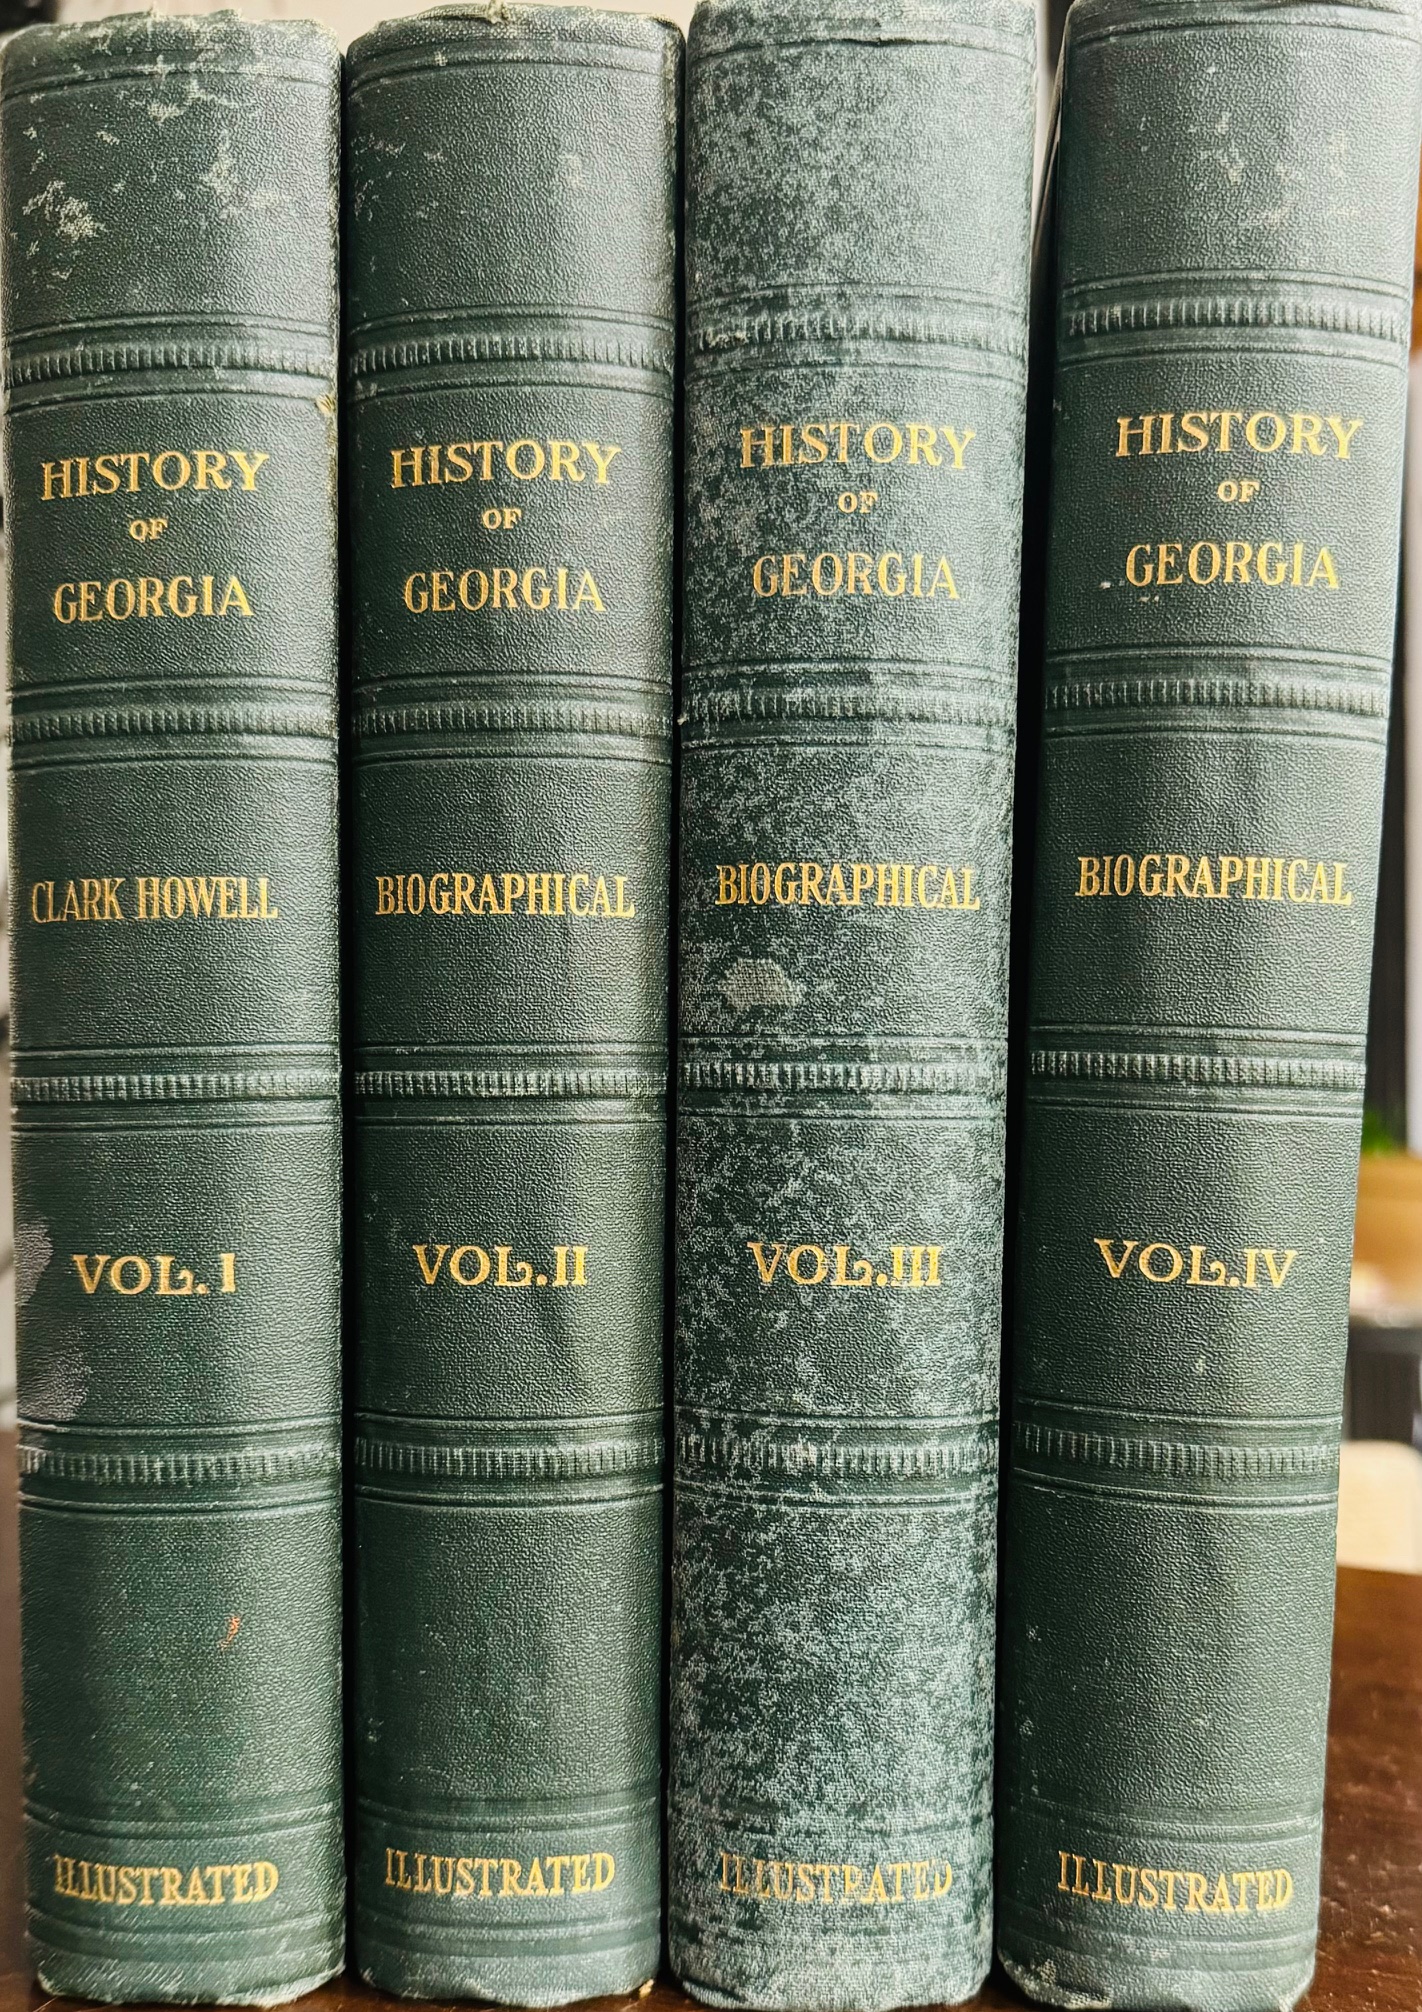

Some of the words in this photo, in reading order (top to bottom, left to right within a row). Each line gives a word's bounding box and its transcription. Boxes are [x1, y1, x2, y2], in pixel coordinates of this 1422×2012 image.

[739, 421, 975, 470] HISTORY
[1116, 411, 1361, 460] HISTORY
[41, 449, 269, 501] HISTORY
[390, 440, 621, 489] HISTORY
[837, 490, 878, 514] OF
[1216, 479, 1260, 503] OF
[128, 517, 169, 542] OF
[481, 507, 523, 530] OF
[752, 552, 958, 600] GEORGIA
[1125, 541, 1339, 589] GEORGIA
[52, 575, 253, 624] GEORGIA
[403, 567, 605, 614] GEORGIA
[31, 878, 124, 924] CLARK
[136, 876, 279, 920] HOWELL
[375, 872, 636, 919] BIOGRAPHICAL
[715, 861, 981, 910] BIOGRAPHICAL
[1075, 854, 1352, 906] BIOGRAPHICAL
[54, 1855, 280, 1907] ILLUSTRATED
[385, 1848, 616, 1898] ILLUSTRATED
[1057, 1851, 1295, 1914] ILLUSTRATED
